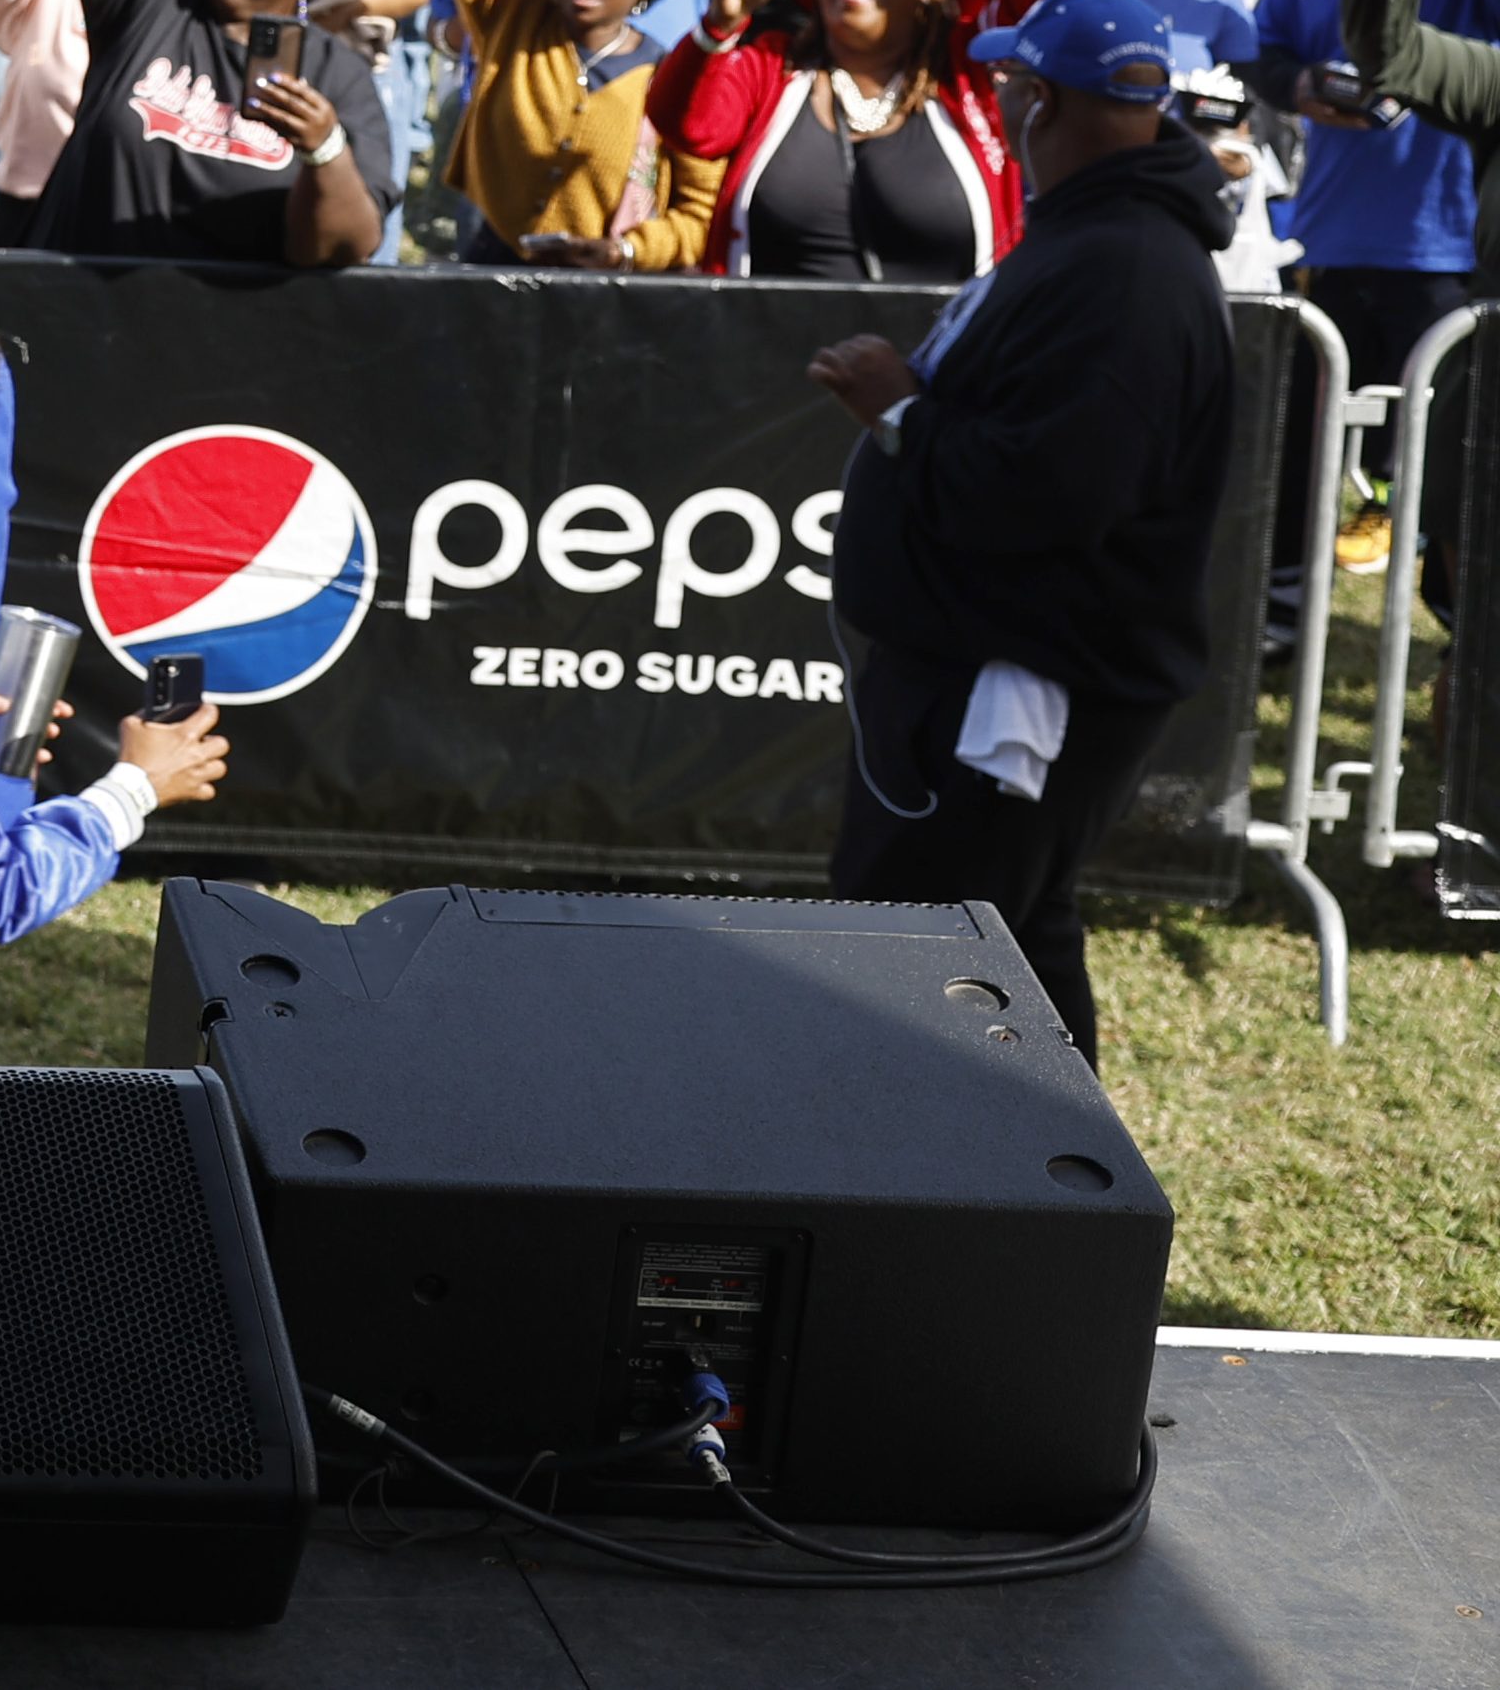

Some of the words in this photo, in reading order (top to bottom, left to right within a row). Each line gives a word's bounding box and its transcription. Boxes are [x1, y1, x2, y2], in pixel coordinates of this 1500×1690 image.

[405, 478, 836, 629] peps
[471, 645, 625, 691] ZERO
[637, 651, 844, 703] SUGAR
